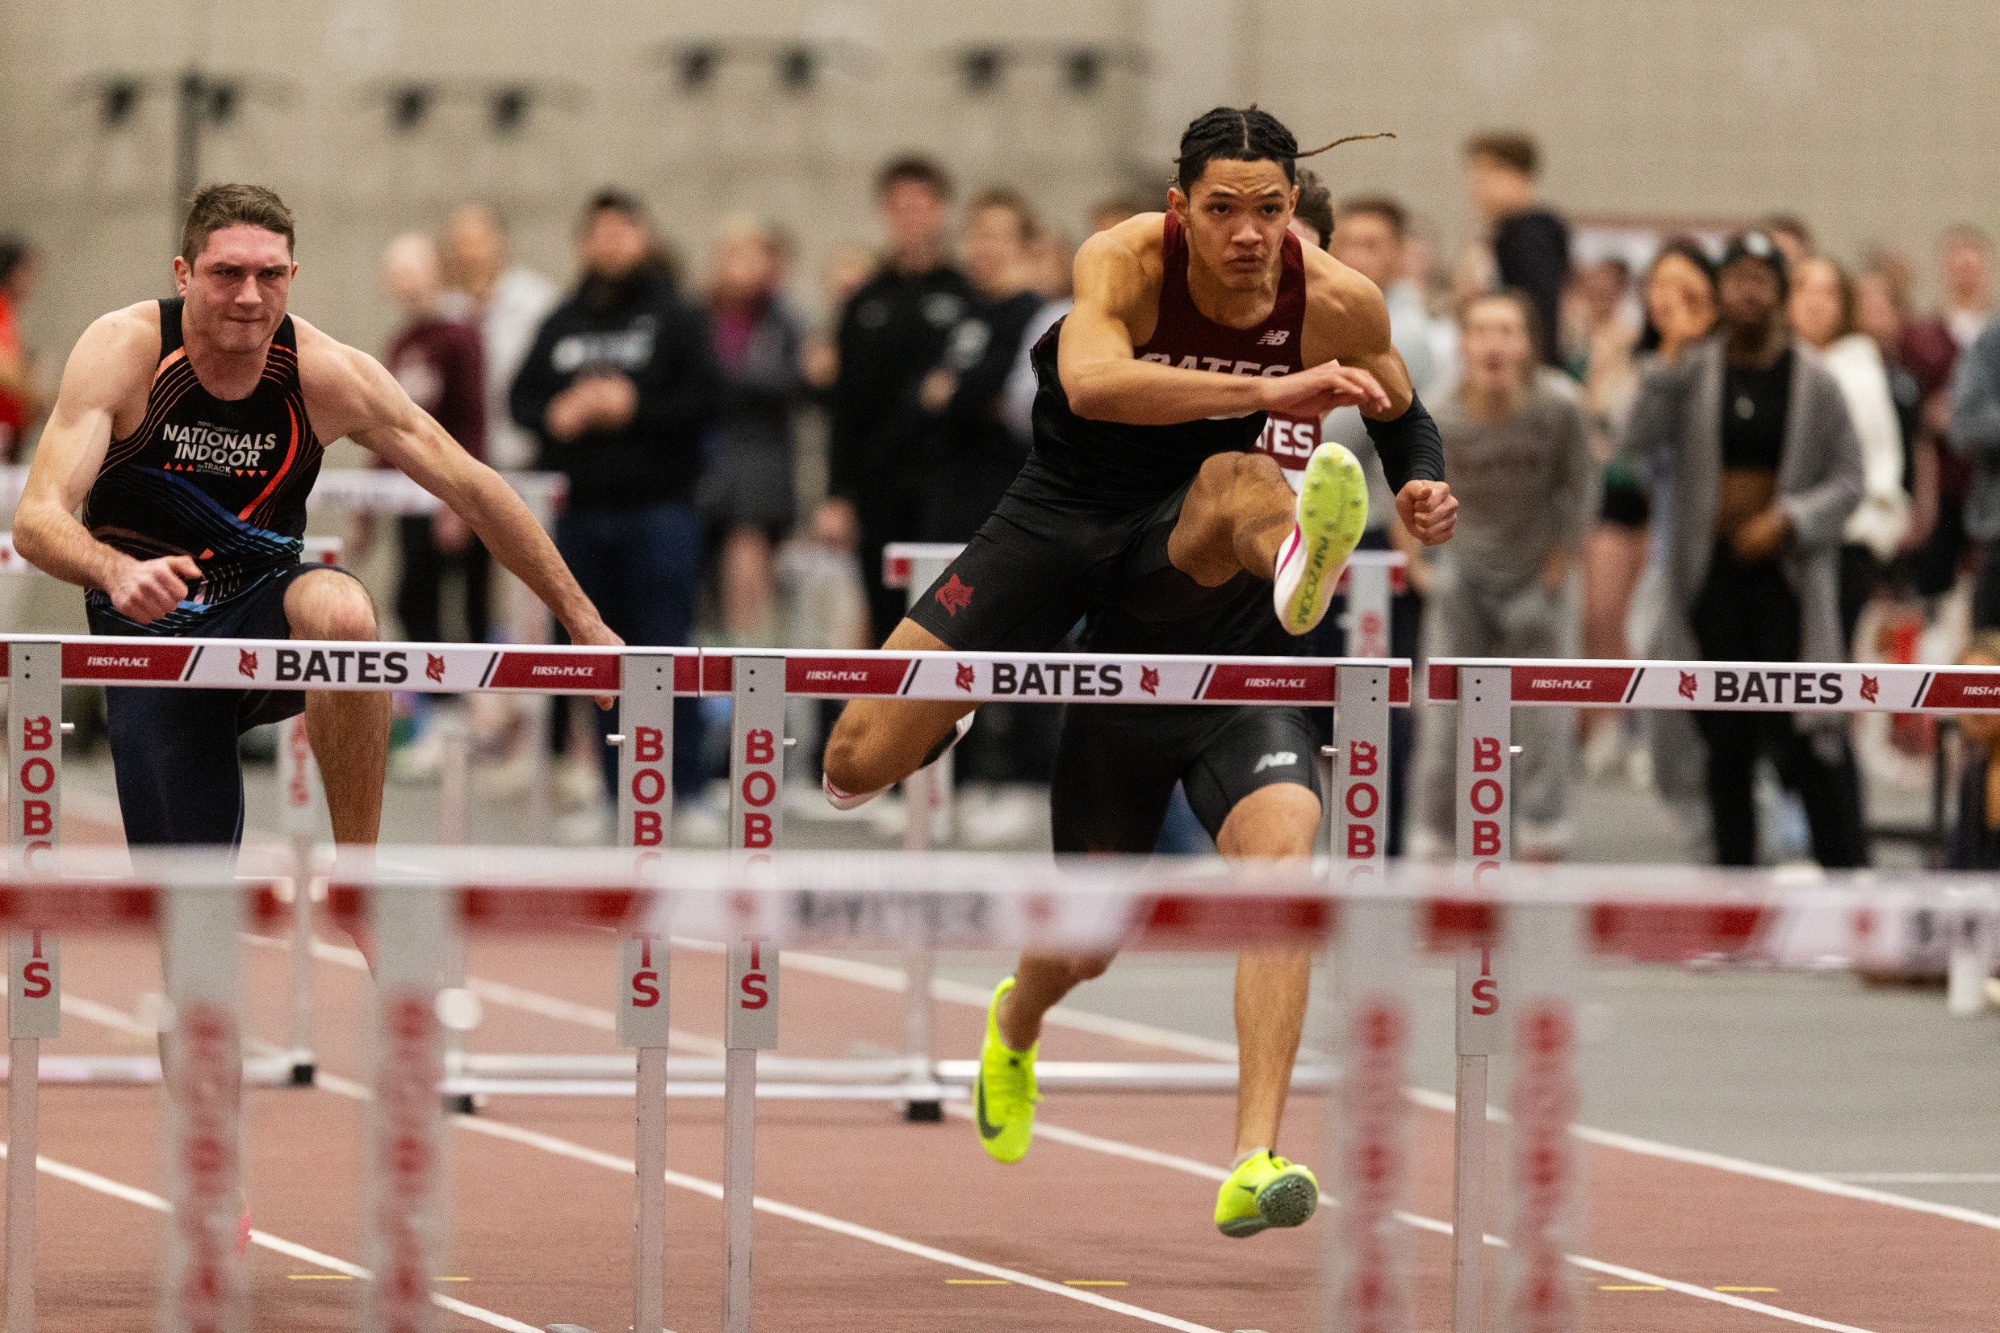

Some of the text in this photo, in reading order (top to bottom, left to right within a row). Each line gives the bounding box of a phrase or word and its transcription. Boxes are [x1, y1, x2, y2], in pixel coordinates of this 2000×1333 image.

[162, 423, 277, 450] NATIONALS
[174, 442, 261, 467] INDOOR
[203, 462, 231, 474] TRACK
[275, 650, 408, 684] BATES
[991, 663, 1123, 696] BATES
[1714, 671, 1843, 705] BATES
